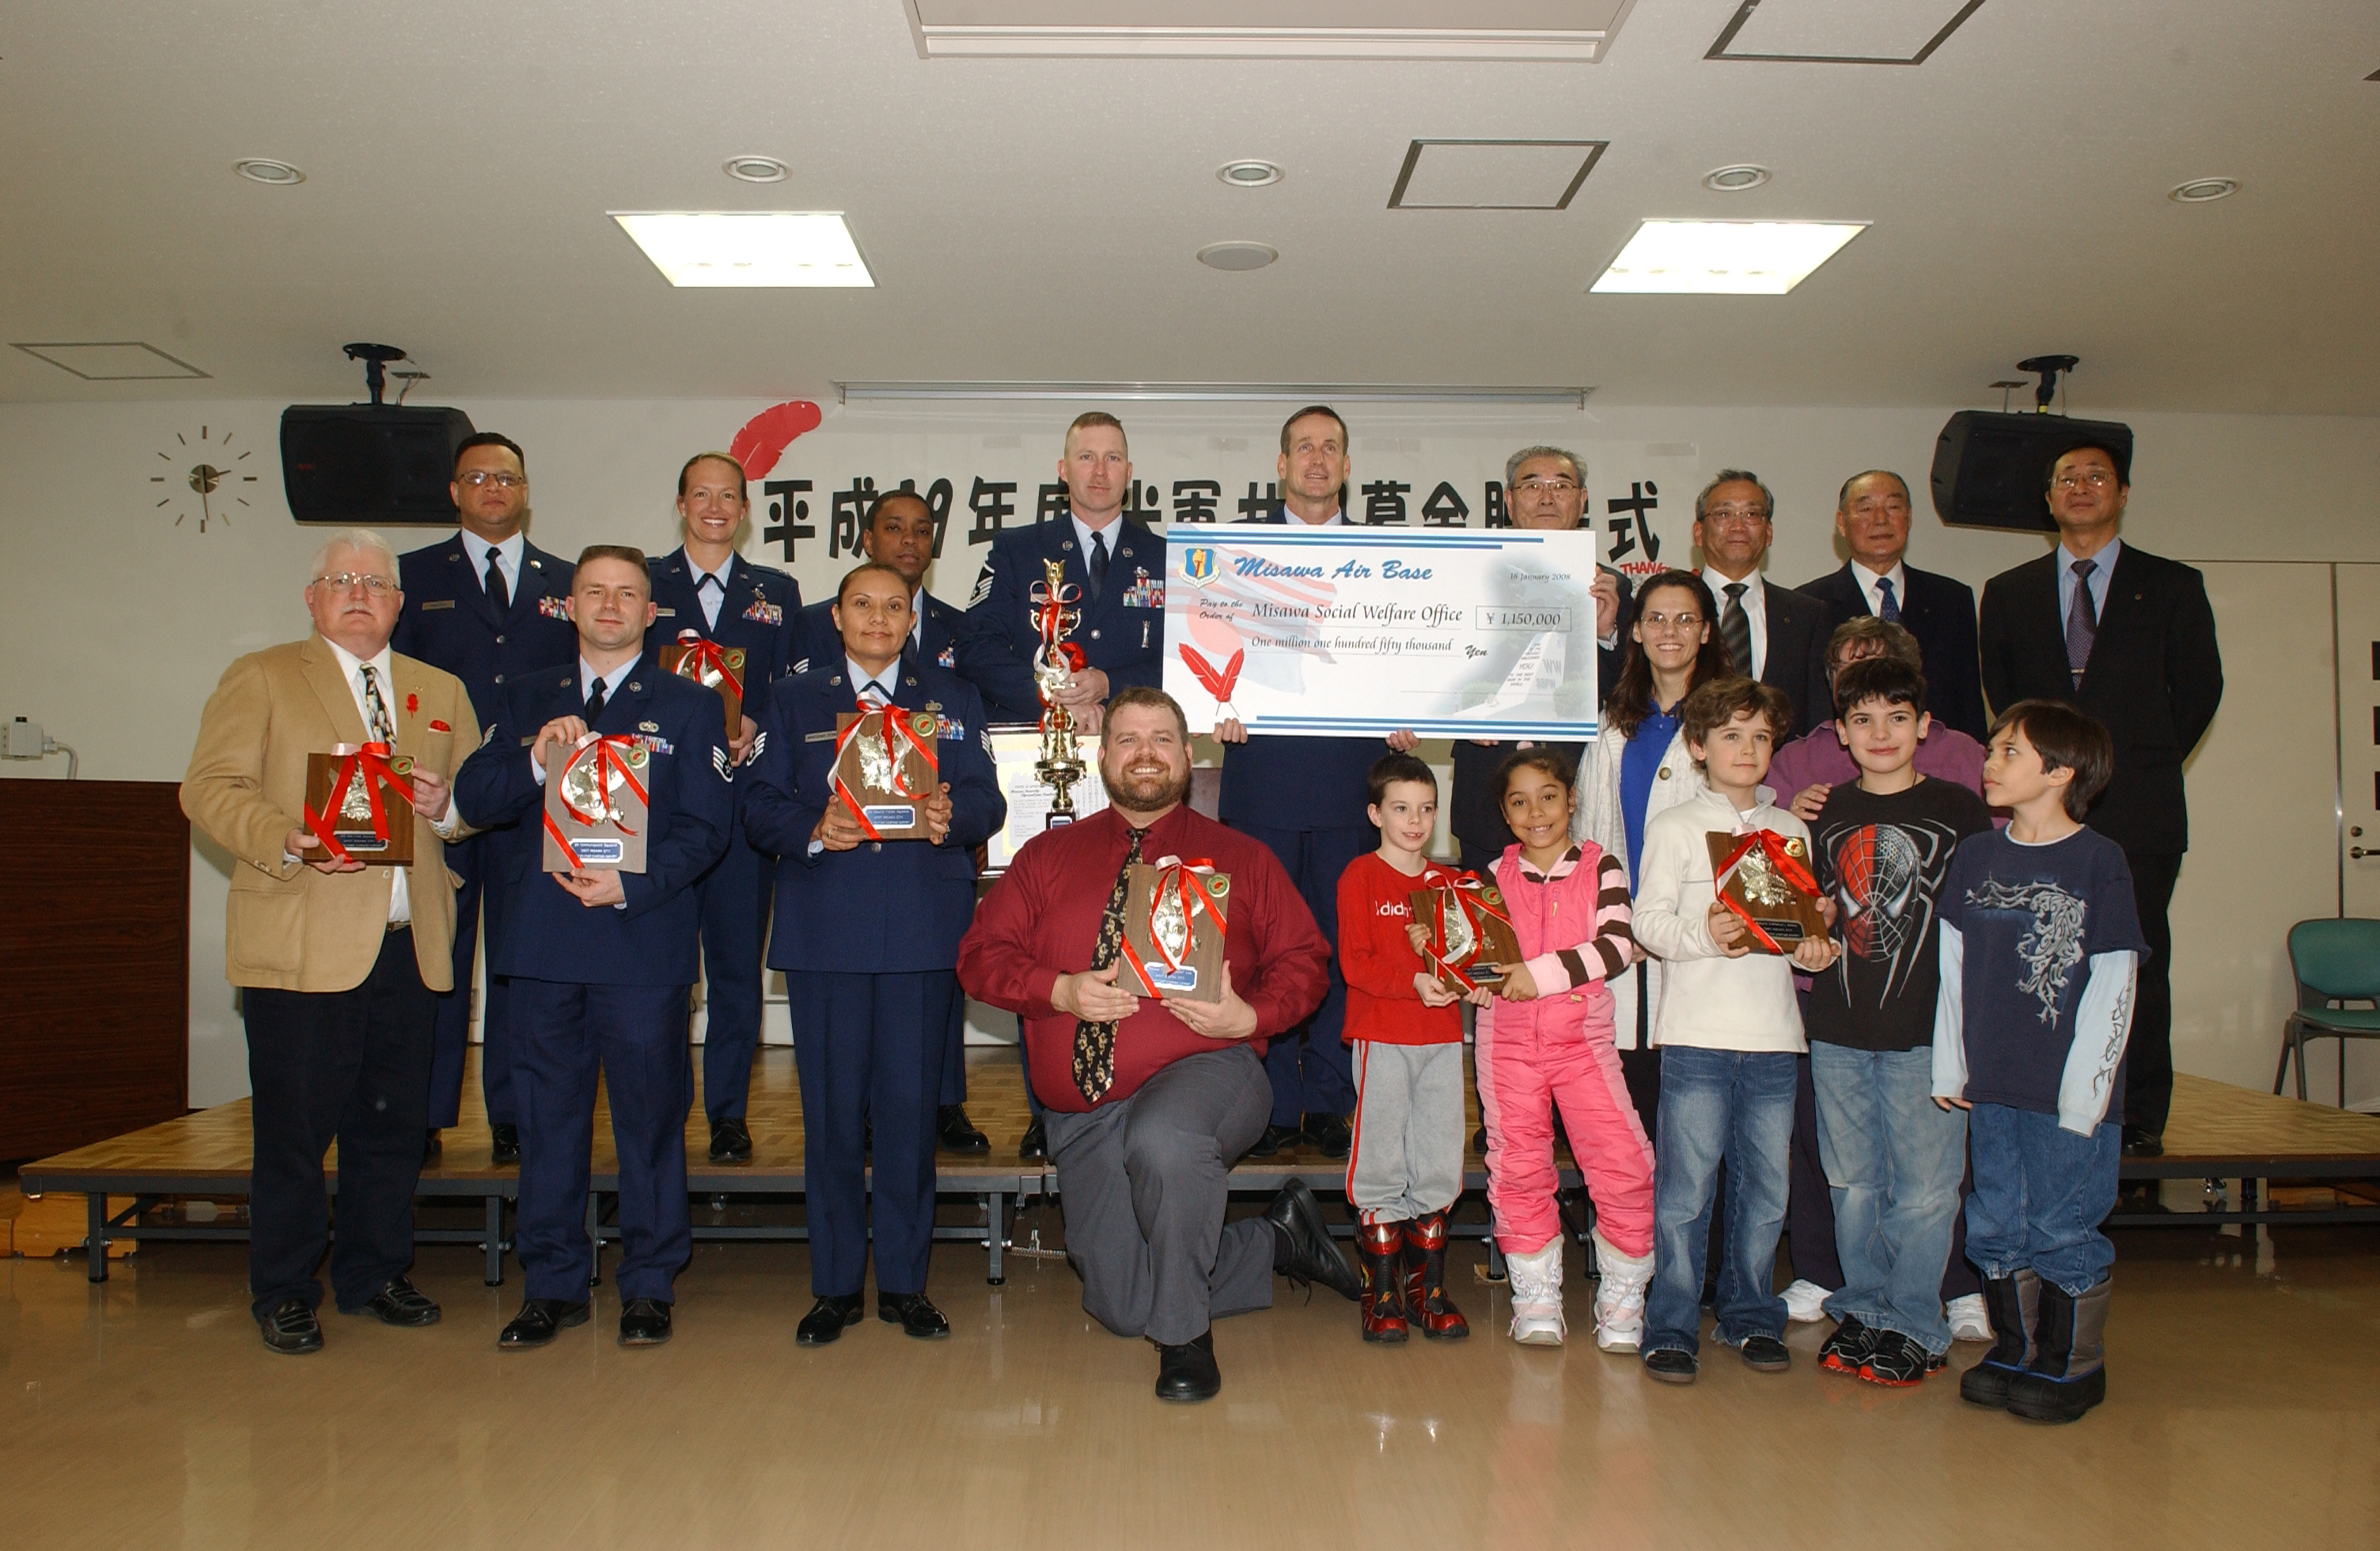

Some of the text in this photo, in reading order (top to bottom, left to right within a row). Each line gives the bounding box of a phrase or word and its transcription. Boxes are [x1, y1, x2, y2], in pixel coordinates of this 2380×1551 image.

[1234, 556, 1433, 580] Misawa Air Base
[1519, 573, 1550, 583] January
[1199, 598, 1218, 609] Pay
[1199, 611, 1234, 622] Order of
[1252, 601, 1463, 628] Misawa Social Welfare Office
[1500, 612, 1561, 626] 1,150,000
[1252, 635, 1488, 660] One million one hundred fifty thousand Yen
